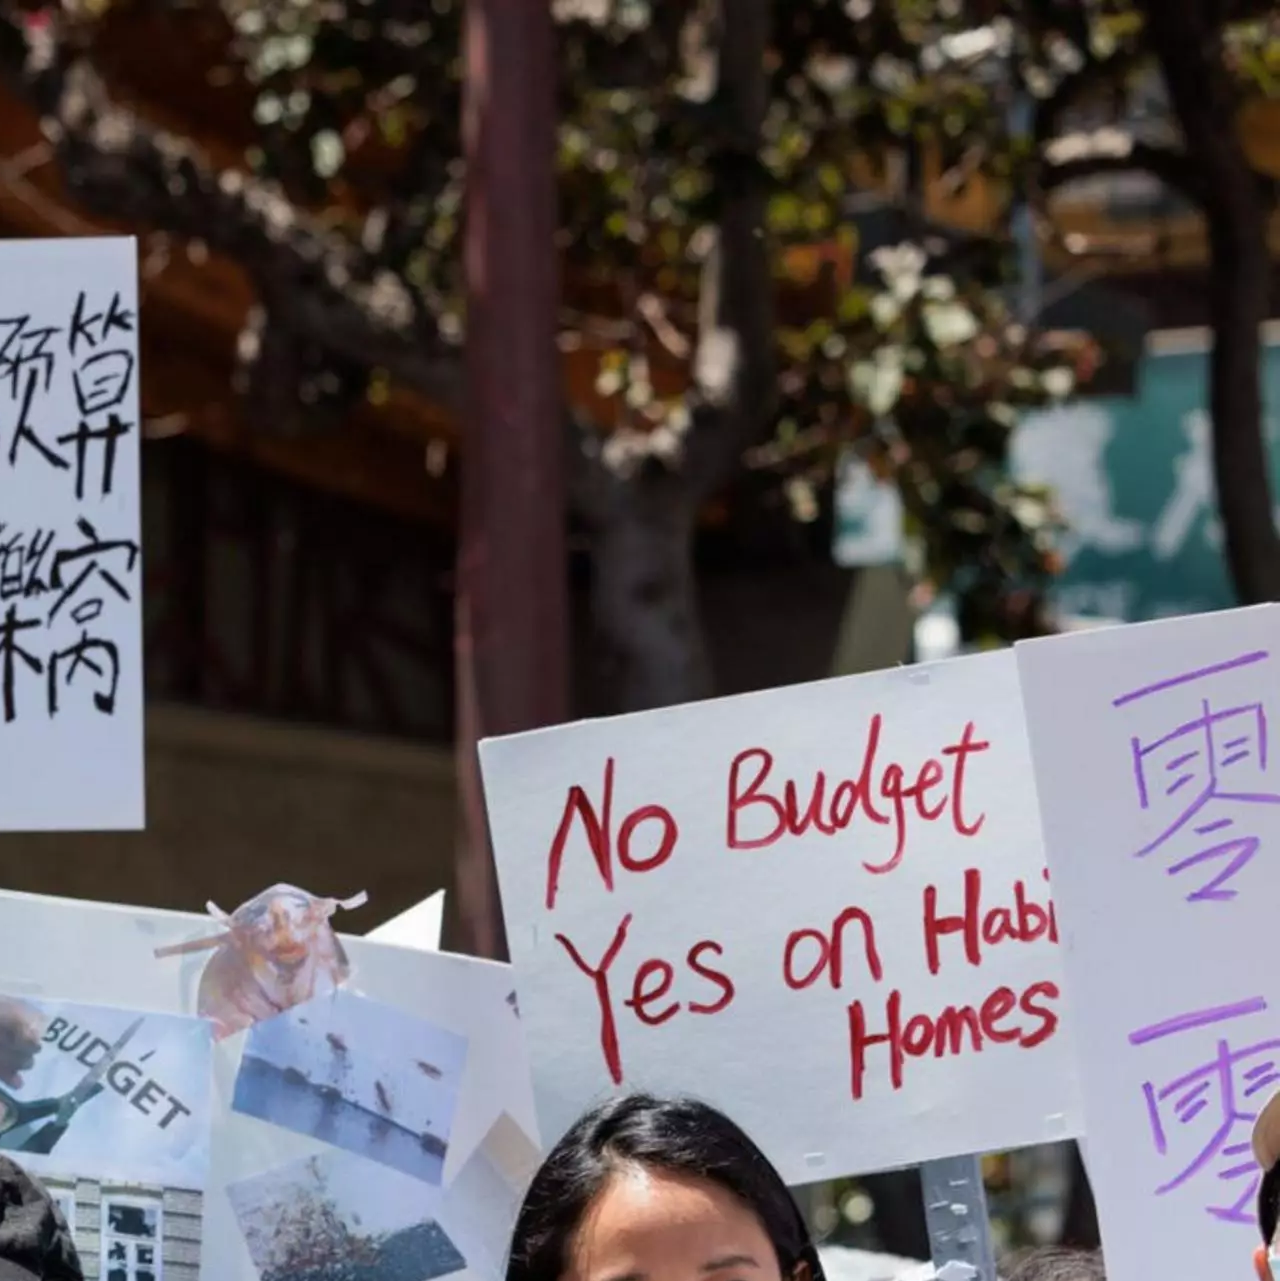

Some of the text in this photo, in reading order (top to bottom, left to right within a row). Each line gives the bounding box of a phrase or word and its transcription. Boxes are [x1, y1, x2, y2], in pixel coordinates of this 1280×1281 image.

[545, 713, 989, 908] No Budget
[555, 913, 735, 1086] Yes
[784, 906, 881, 990] on
[848, 980, 1060, 1100] Homes
[40, 1015, 192, 1130] BUDGET
